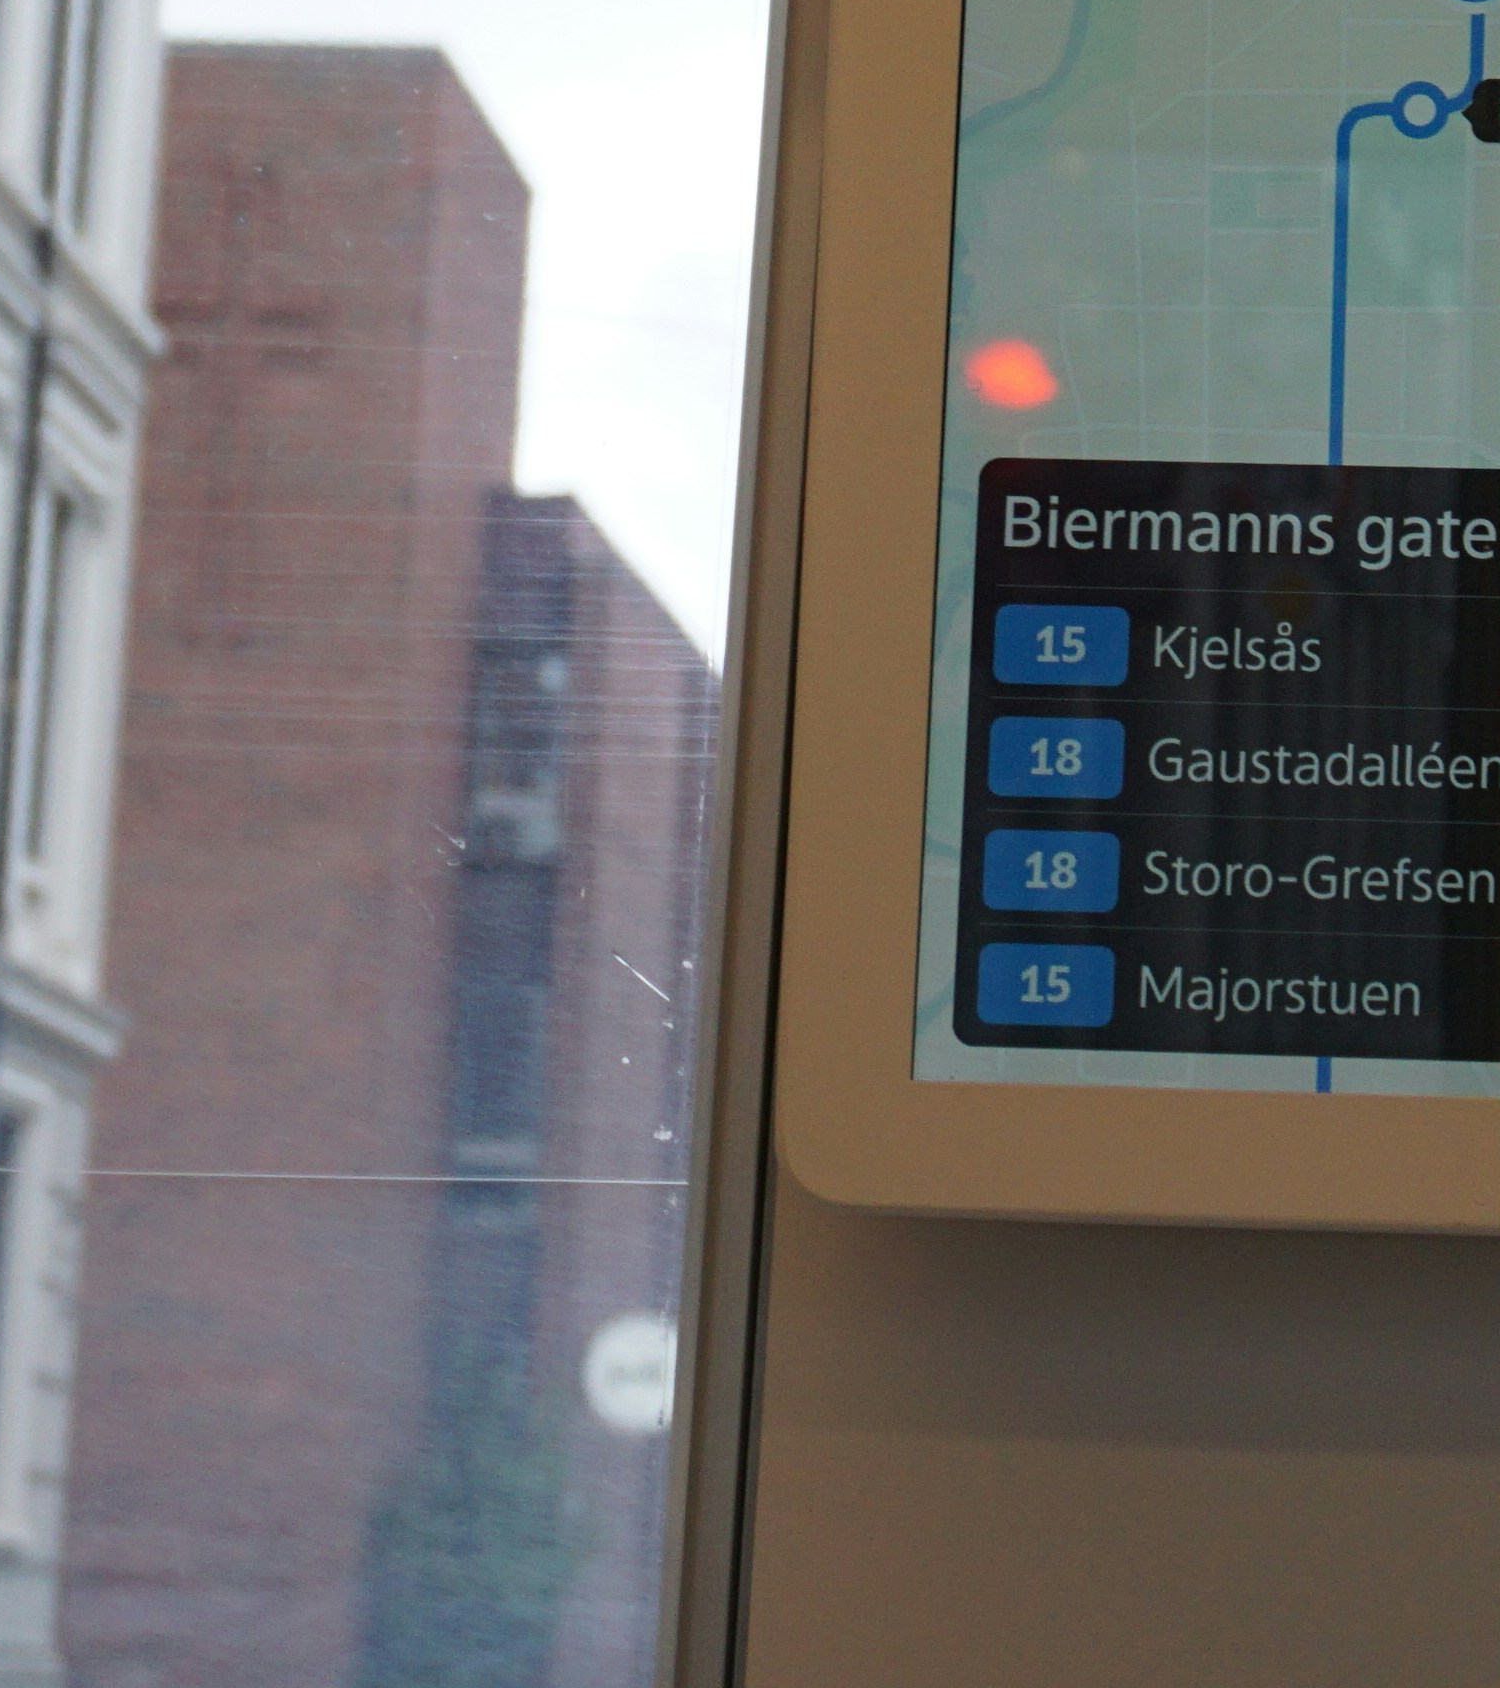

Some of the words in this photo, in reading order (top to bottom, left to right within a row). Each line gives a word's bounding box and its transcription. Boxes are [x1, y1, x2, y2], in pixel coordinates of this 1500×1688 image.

[1004, 495, 1335, 556] Biermanns
[1357, 510, 1497, 571] gate
[1036, 625, 1086, 663] 15
[1154, 621, 1321, 680] Kjelsås
[1030, 737, 1083, 776] 18
[1025, 850, 1077, 890] 18
[1143, 850, 1495, 904] Storo-Grefsen
[1021, 964, 1071, 1003] 15
[1139, 965, 1420, 1022] Majorstuen
